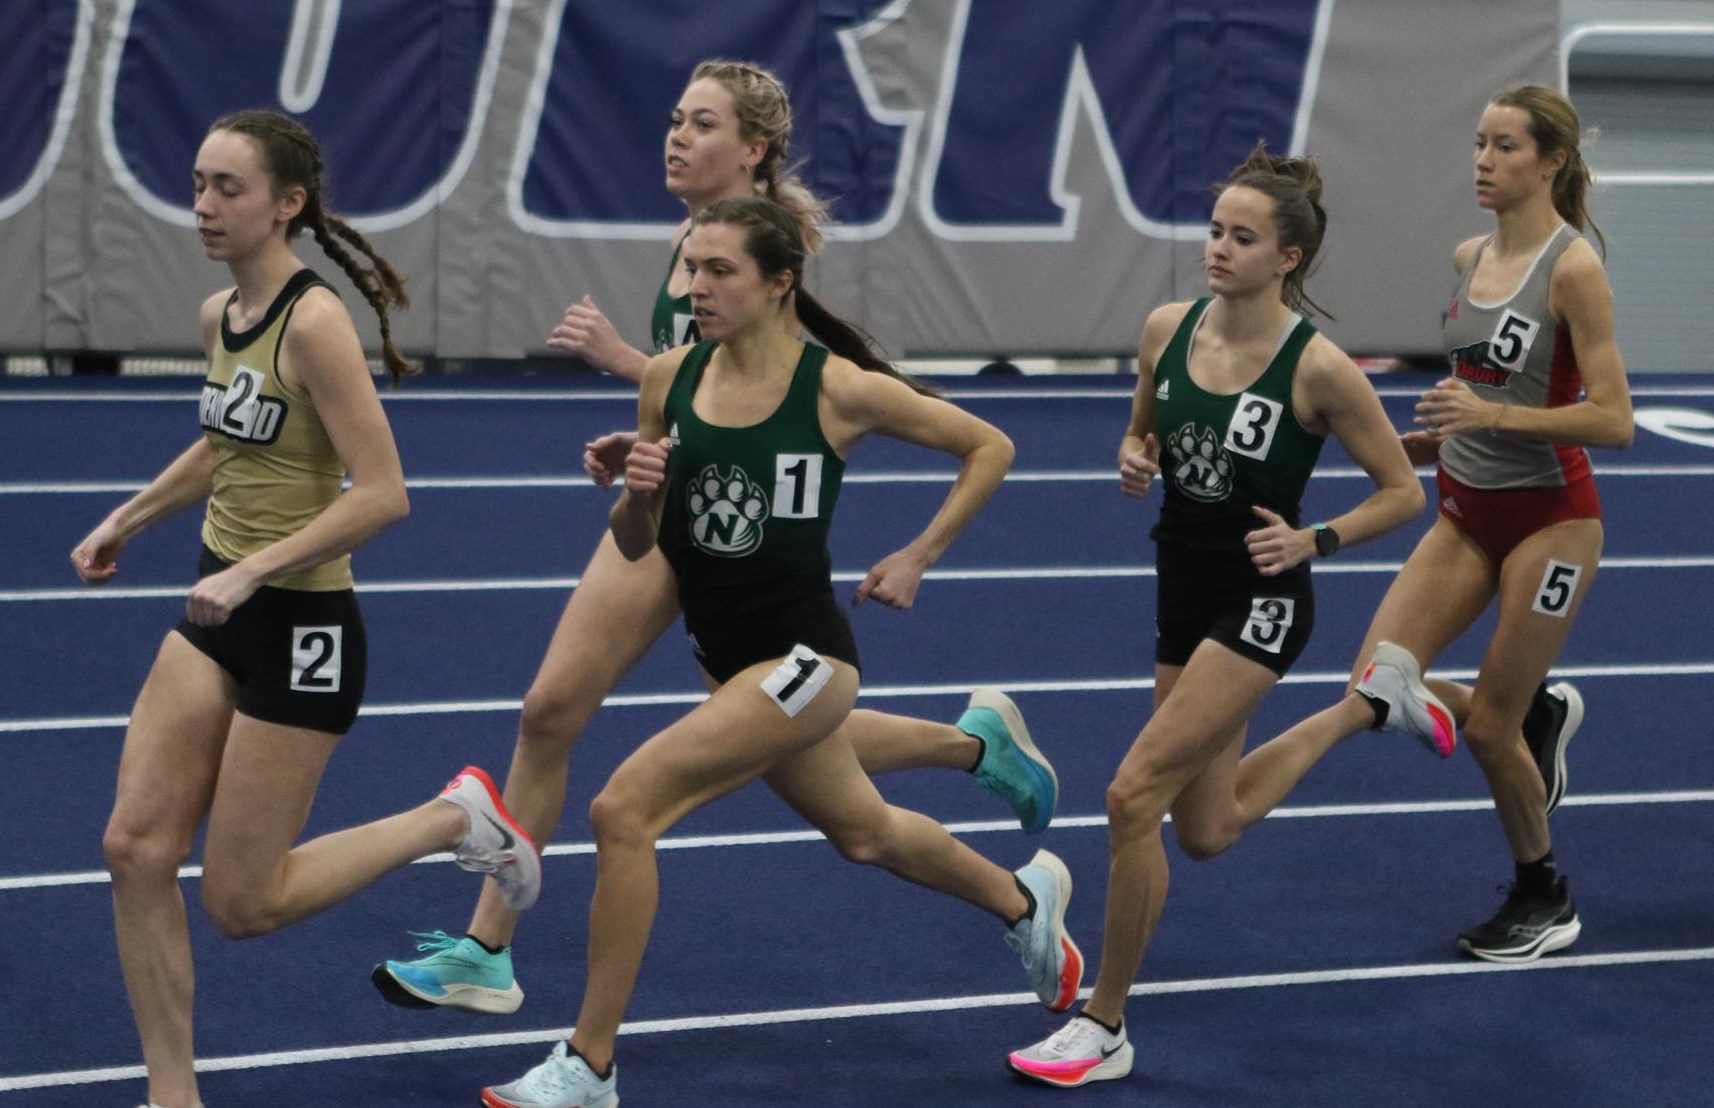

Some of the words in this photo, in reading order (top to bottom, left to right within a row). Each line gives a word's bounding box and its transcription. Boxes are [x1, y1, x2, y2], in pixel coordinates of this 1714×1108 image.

[1494, 315, 1531, 364] 5
[222, 371, 254, 432] 2
[1233, 400, 1272, 452] 3
[784, 459, 808, 515] 1
[1183, 463, 1212, 490] N
[702, 512, 740, 546] N
[1540, 565, 1575, 612] 5
[1251, 600, 1287, 646] 3
[298, 631, 335, 688] 2
[776, 657, 821, 703] 1
